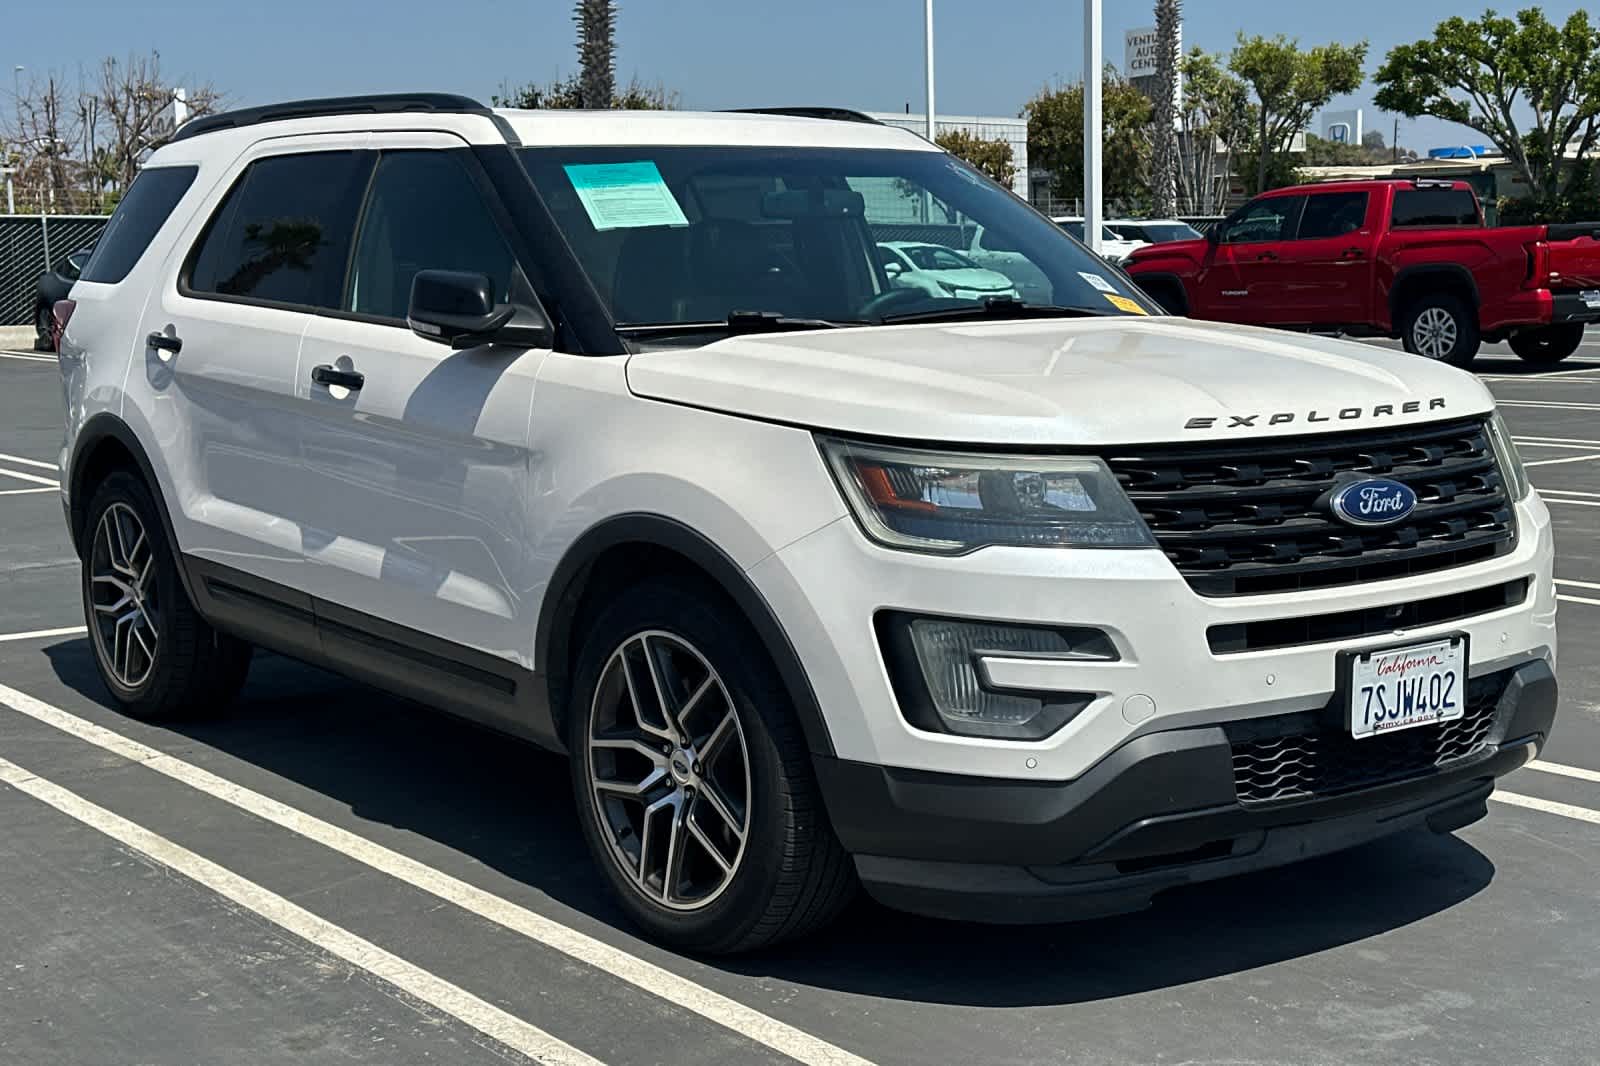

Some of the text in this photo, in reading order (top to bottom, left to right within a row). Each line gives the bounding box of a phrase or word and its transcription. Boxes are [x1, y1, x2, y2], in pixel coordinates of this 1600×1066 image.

[1127, 32, 1160, 47] VENTU
[1131, 57, 1160, 70] CENT
[1183, 397, 1446, 430] EXPLORER
[1359, 486, 1404, 515] Ford
[1376, 651, 1444, 677] California
[1361, 671, 1456, 725] 7SJW402
